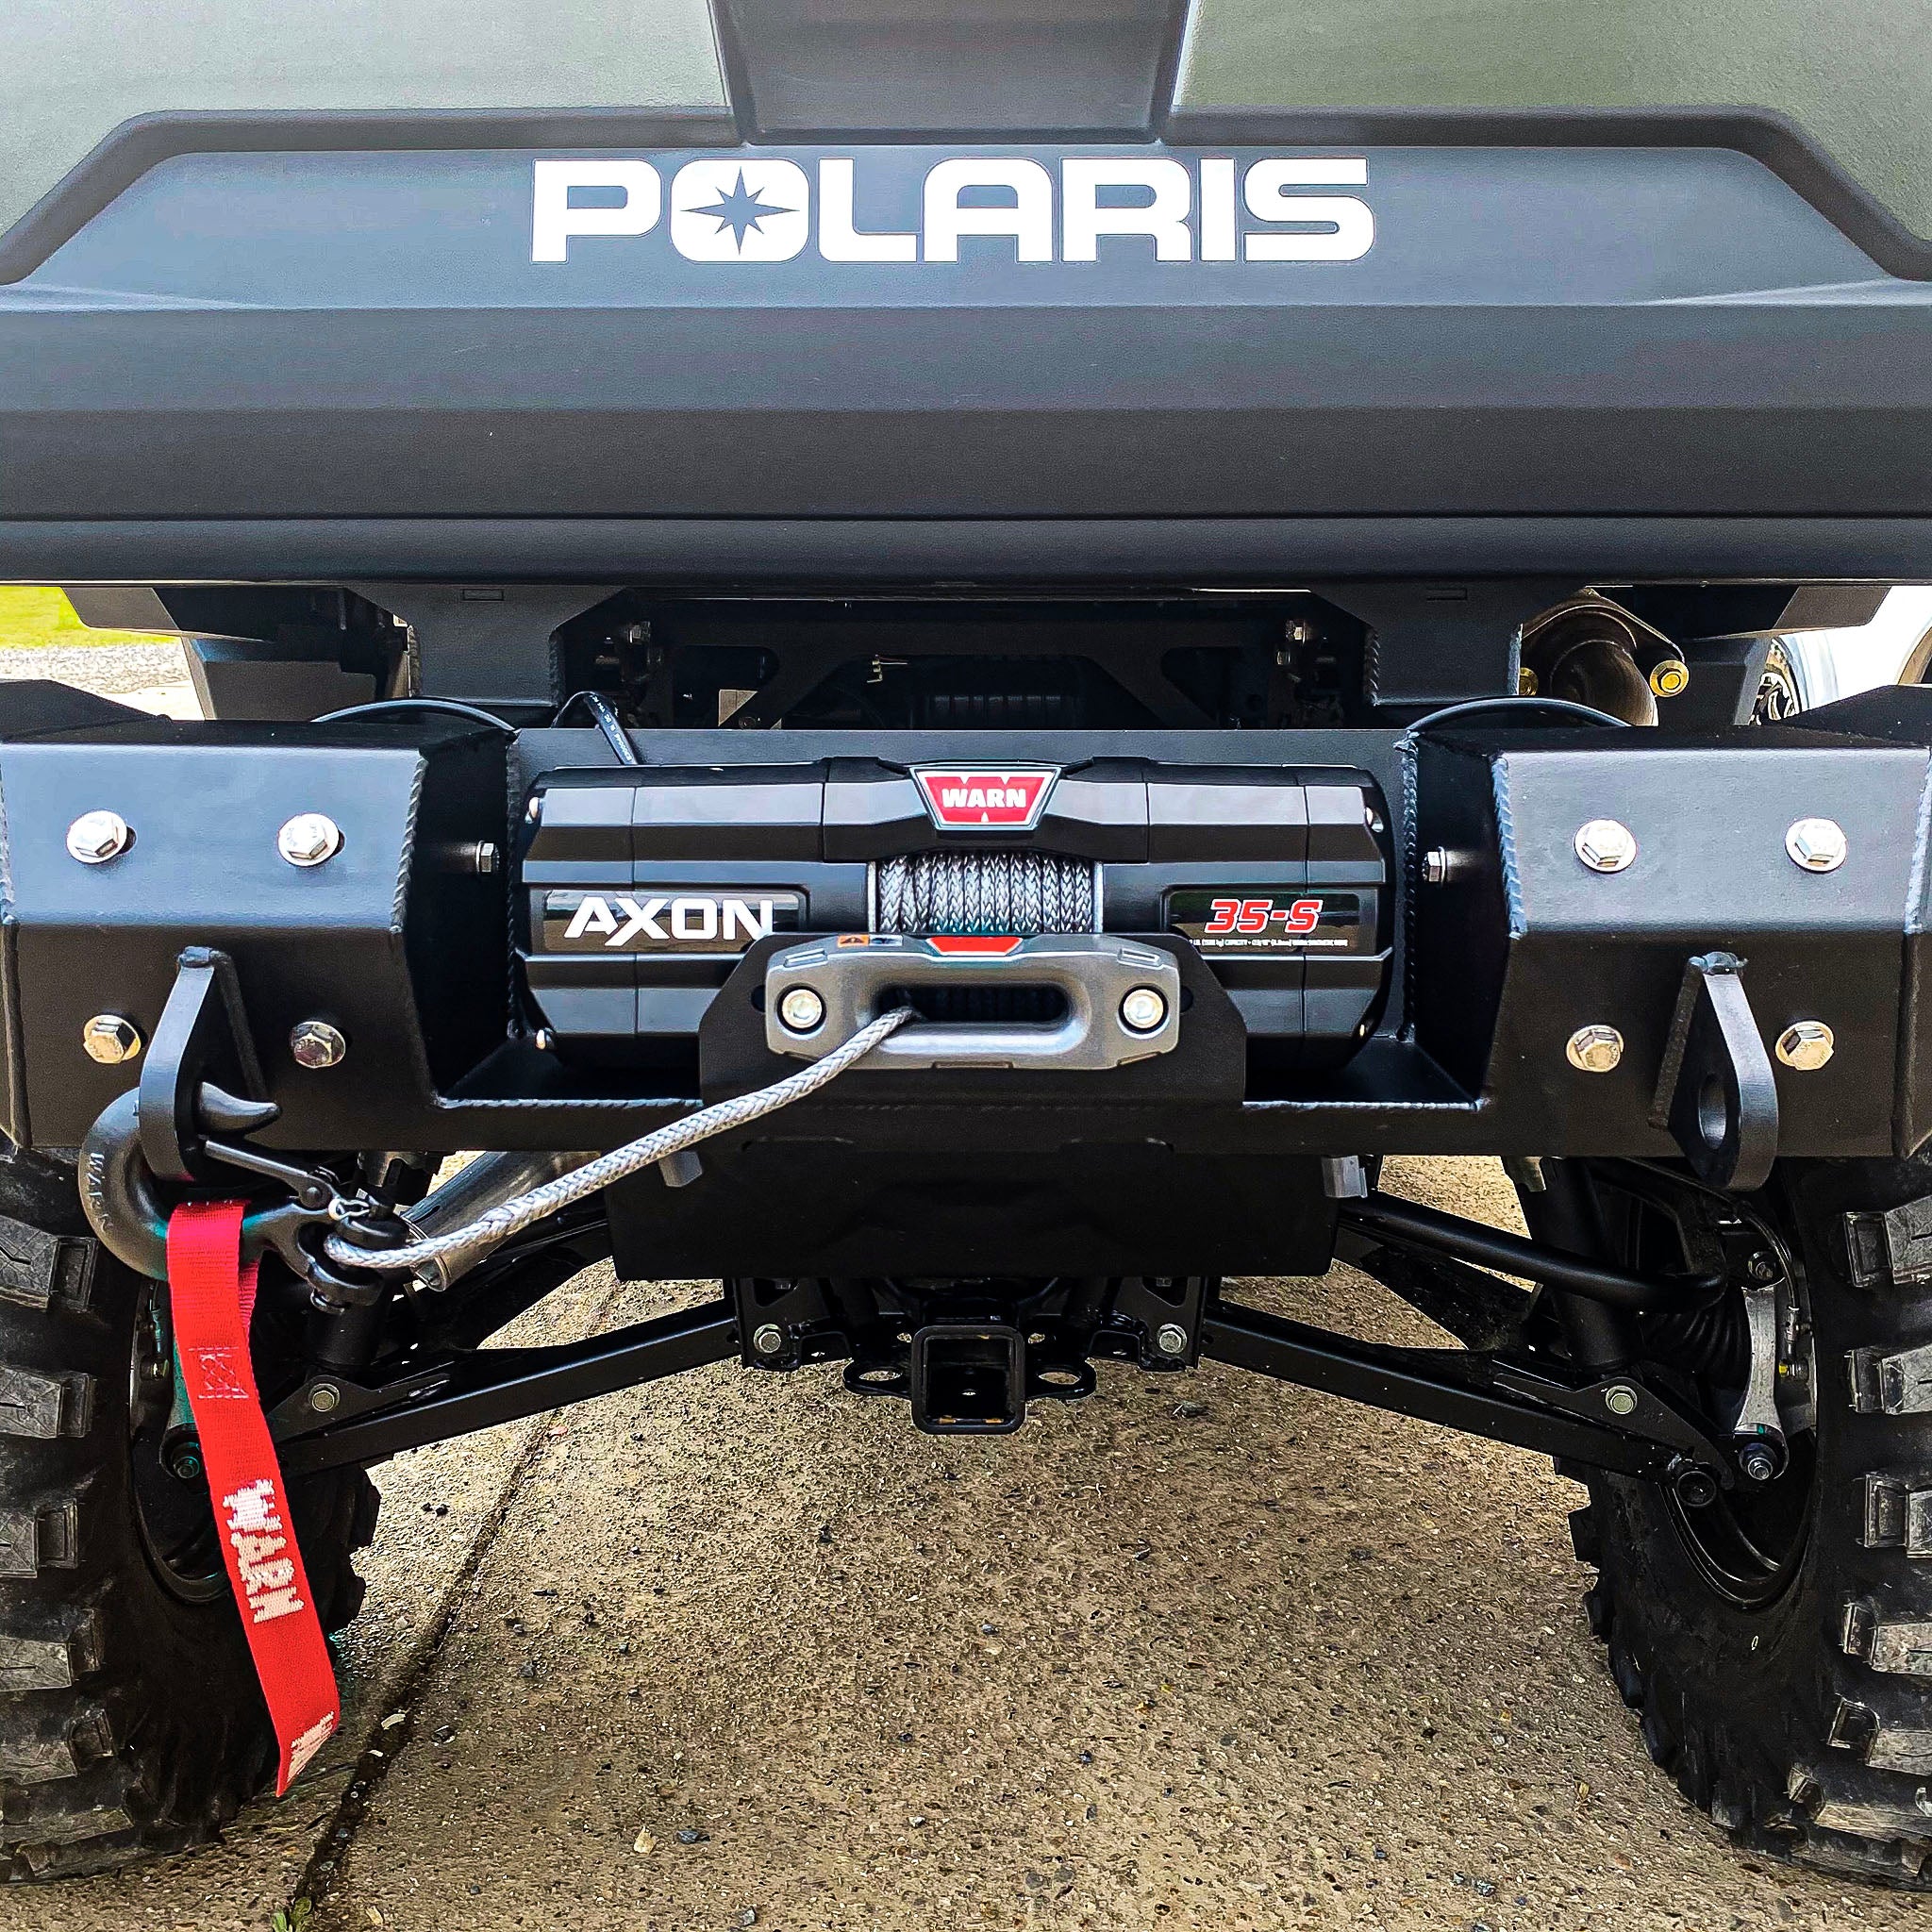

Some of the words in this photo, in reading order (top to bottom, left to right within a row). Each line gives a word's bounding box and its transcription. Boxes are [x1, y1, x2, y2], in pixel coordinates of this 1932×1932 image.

[531, 158, 1374, 263] POLARIS
[941, 789, 1026, 808] WARN
[564, 896, 774, 947] AXON
[1204, 899, 1324, 934] 35-S
[223, 1478, 305, 1624] WARN
